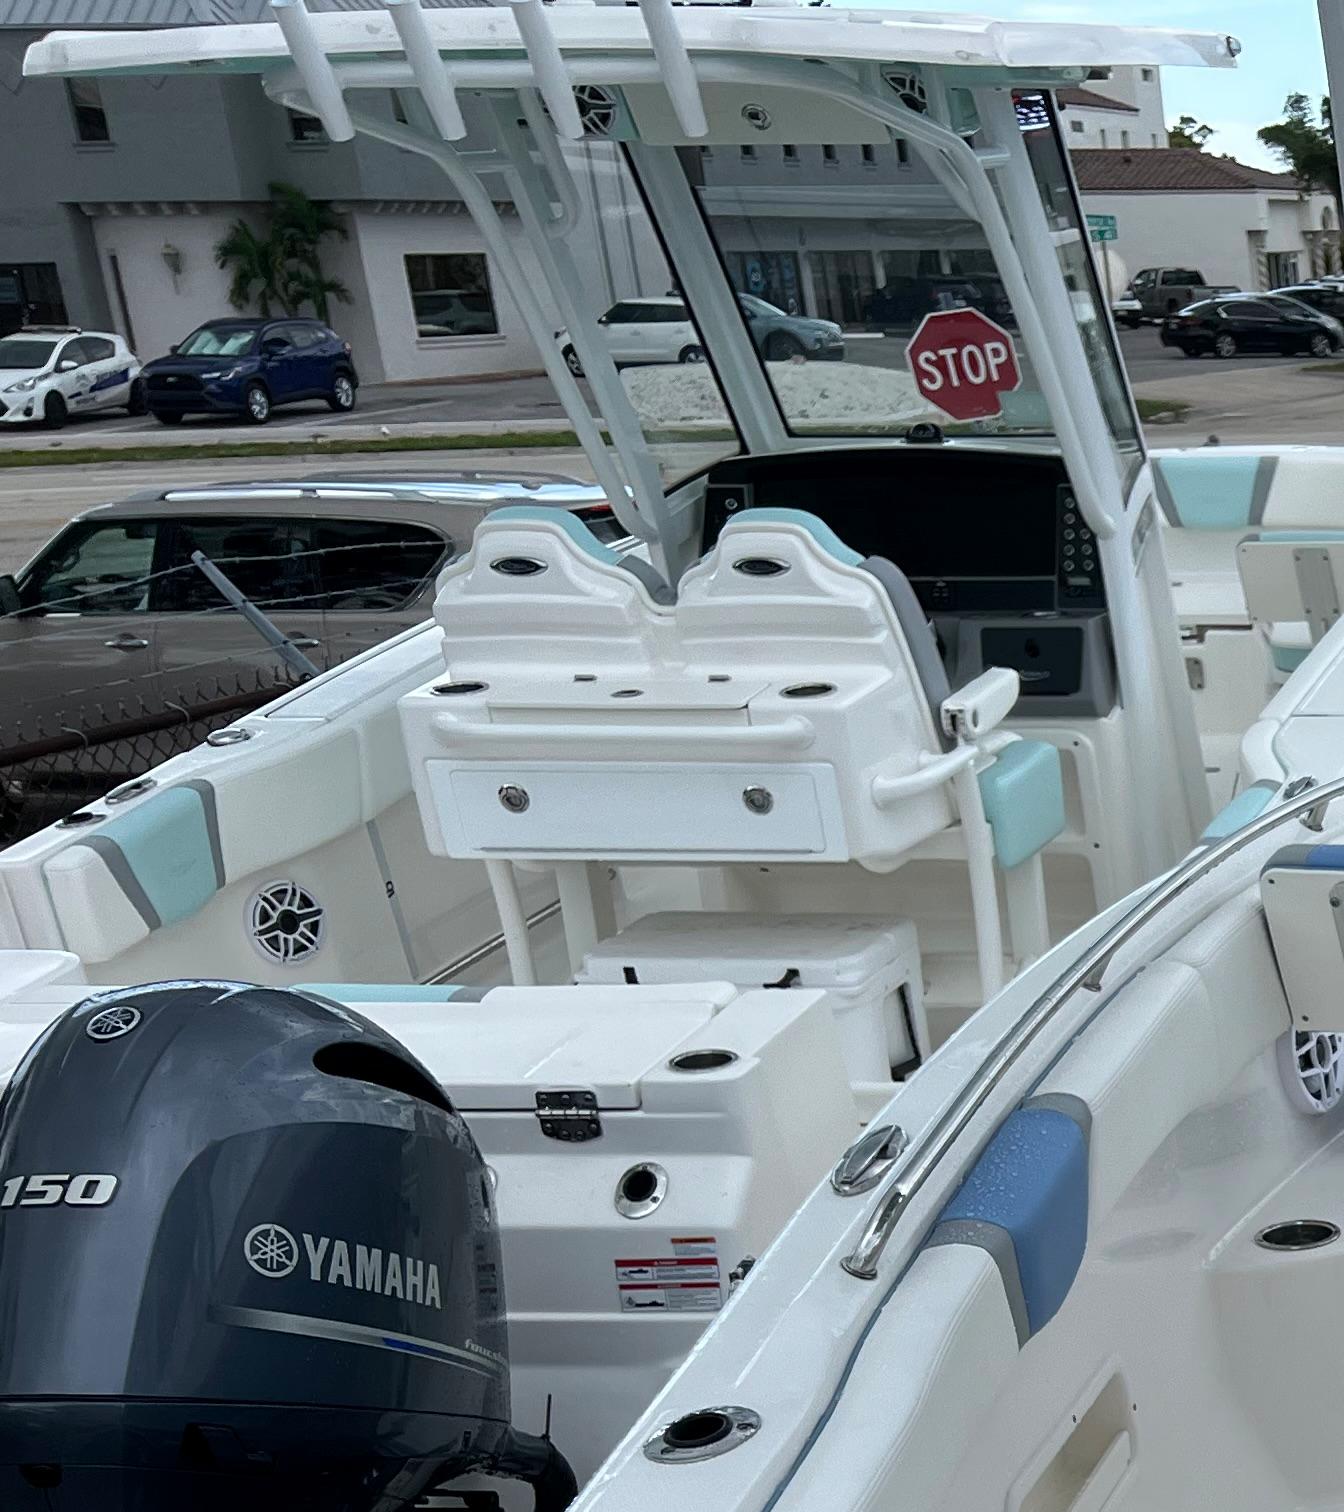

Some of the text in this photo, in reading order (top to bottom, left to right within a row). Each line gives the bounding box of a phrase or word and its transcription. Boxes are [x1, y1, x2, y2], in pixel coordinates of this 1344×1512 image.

[917, 341, 1008, 391] STOP
[1, 1174, 118, 1207] 150
[302, 1233, 442, 1309] YAMAHA
